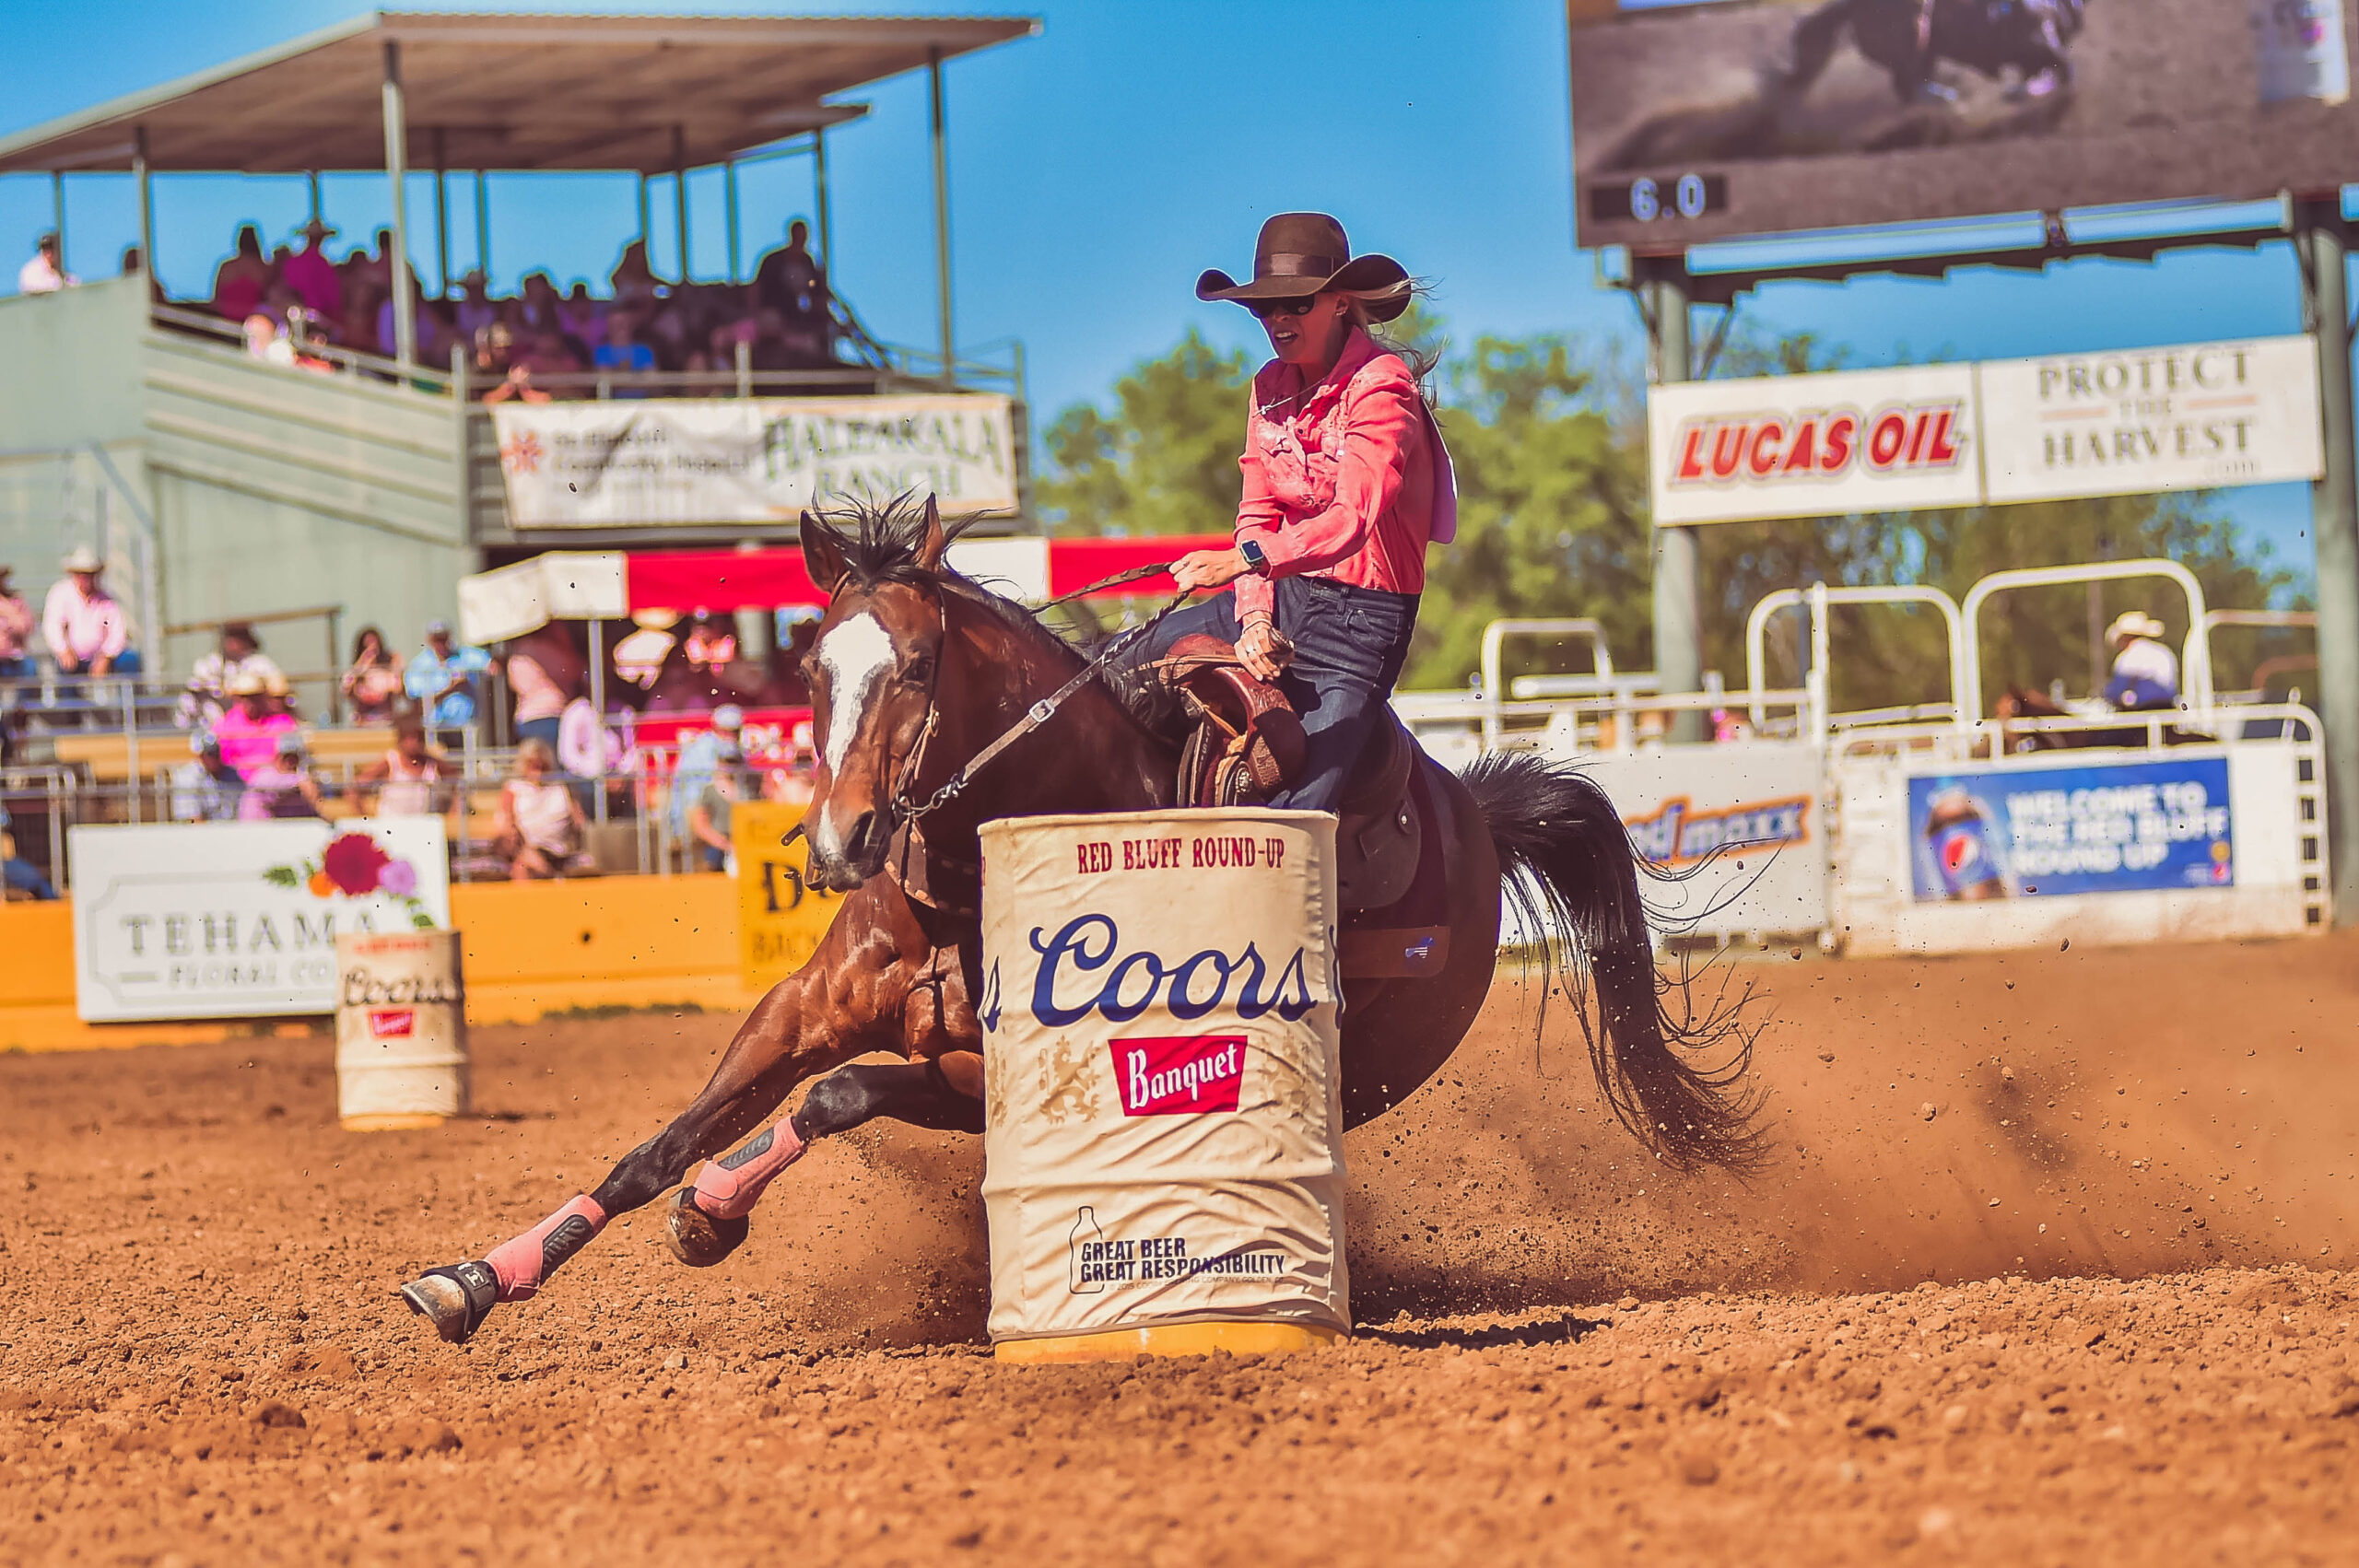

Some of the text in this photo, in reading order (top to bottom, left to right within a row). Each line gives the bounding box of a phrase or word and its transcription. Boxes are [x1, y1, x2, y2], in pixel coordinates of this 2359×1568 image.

[1631, 173, 1706, 221] 6.0
[2039, 348, 2257, 398] PROTECT
[1679, 410, 1955, 477] LUCAS OIL
[2044, 416, 2254, 464] HARVEST
[1077, 837, 1285, 873] RED BLUFF ROUND-UP
[1029, 912, 1319, 1029] Coors
[1127, 1042, 1238, 1110] Banquet
[1080, 1261, 1135, 1283] GREAT
[1141, 1254, 1285, 1281] RESPONSIBILITY
[1081, 1237, 1186, 1262] GREAT BEER
